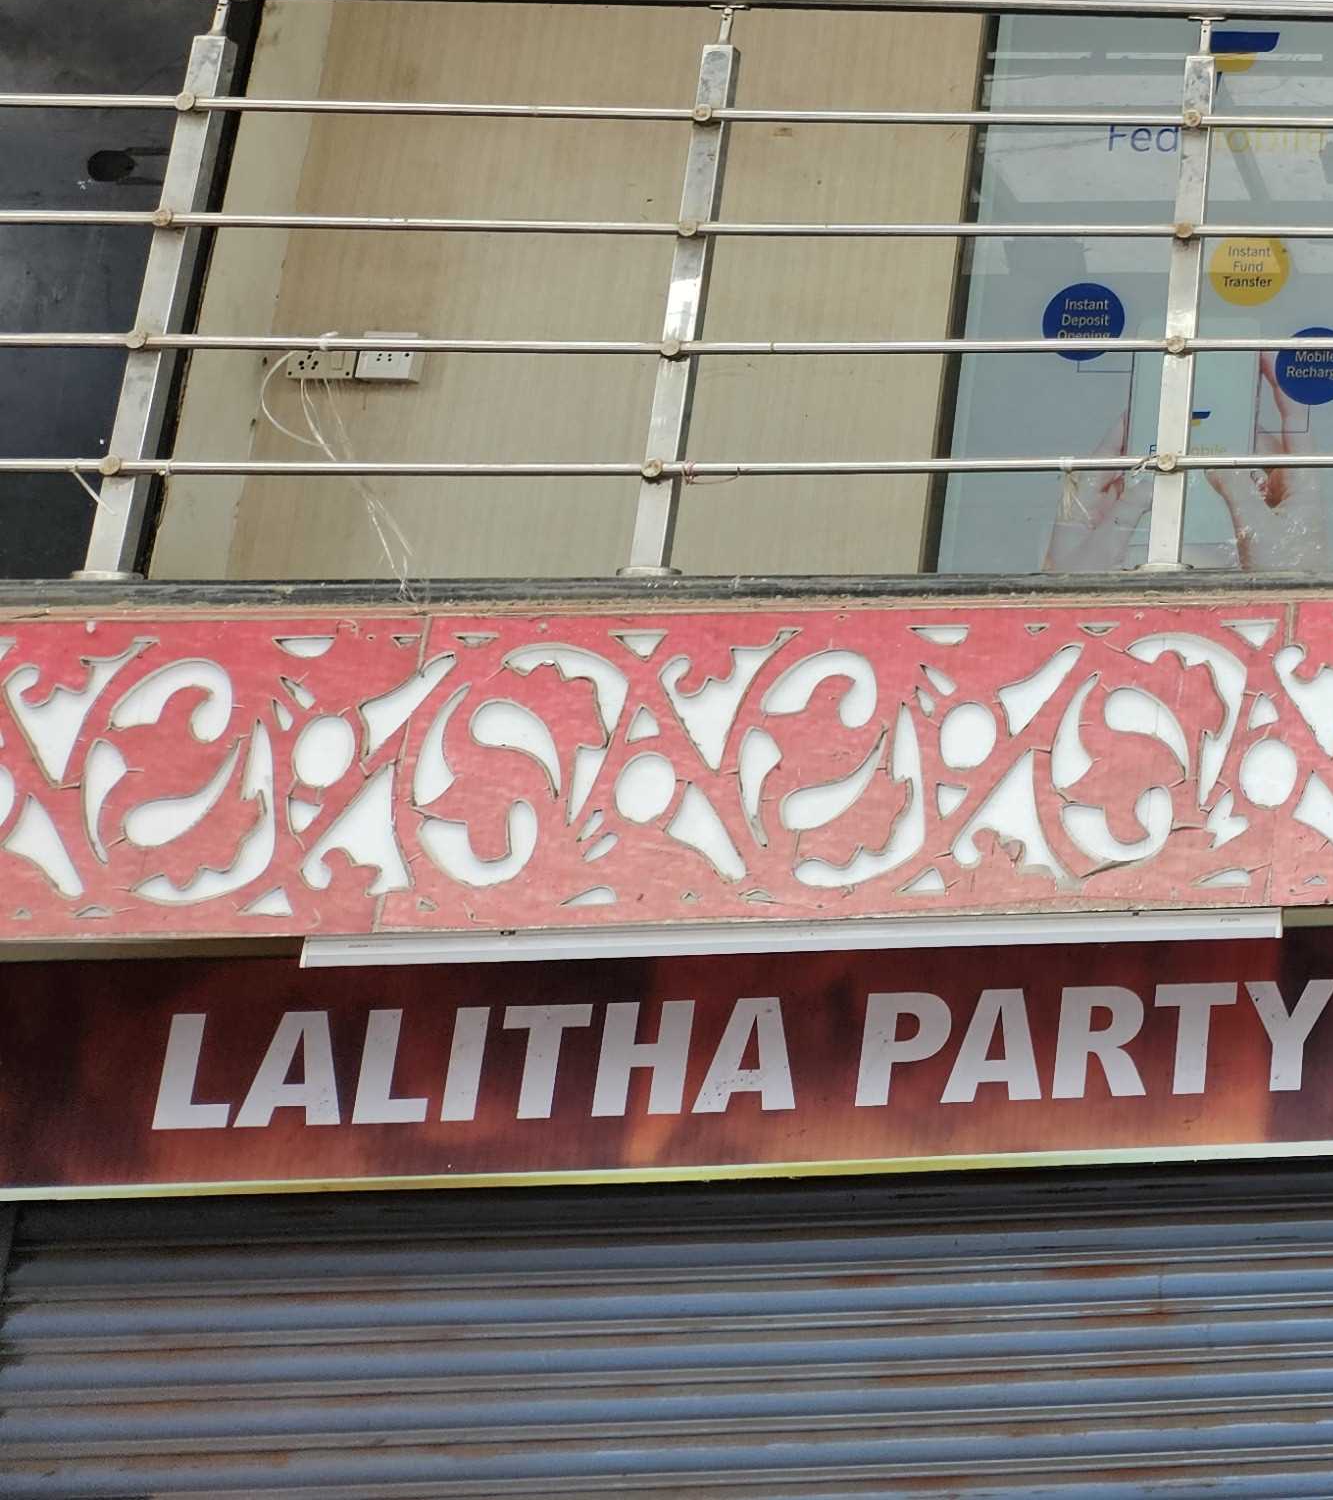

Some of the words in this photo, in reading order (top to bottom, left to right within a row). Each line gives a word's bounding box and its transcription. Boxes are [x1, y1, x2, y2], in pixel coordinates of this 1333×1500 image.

[1227, 245, 1271, 258] Instant
[1233, 260, 1264, 273] Fund
[1223, 275, 1272, 288] Transfer
[1065, 298, 1109, 311] Instant
[1061, 313, 1109, 328] Deposit
[151, 998, 796, 1131] LALITHA
